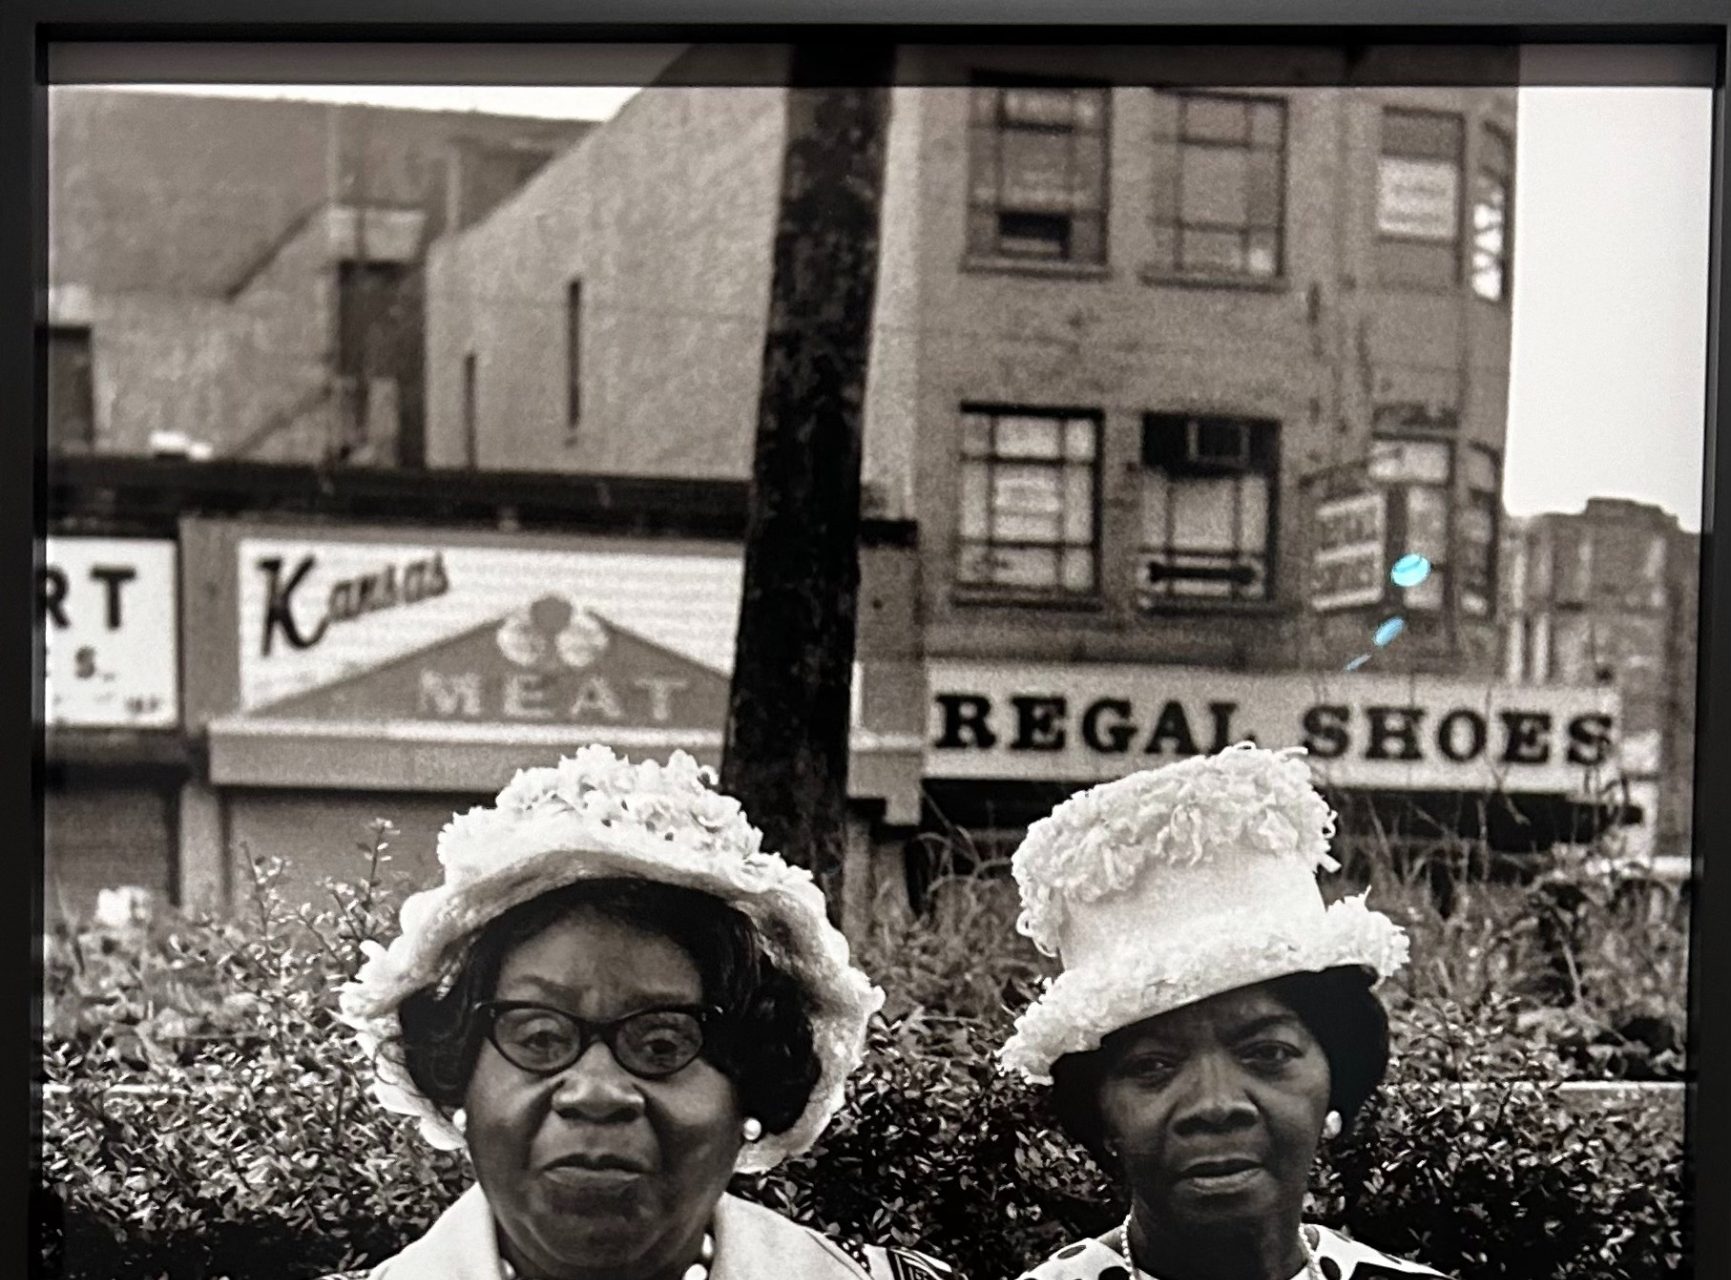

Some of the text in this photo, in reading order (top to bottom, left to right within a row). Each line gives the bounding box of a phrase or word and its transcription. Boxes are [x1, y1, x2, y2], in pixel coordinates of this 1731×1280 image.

[258, 553, 450, 658] Kansas
[419, 669, 689, 721] MEAT
[934, 693, 1614, 766] REGAL SHOES
